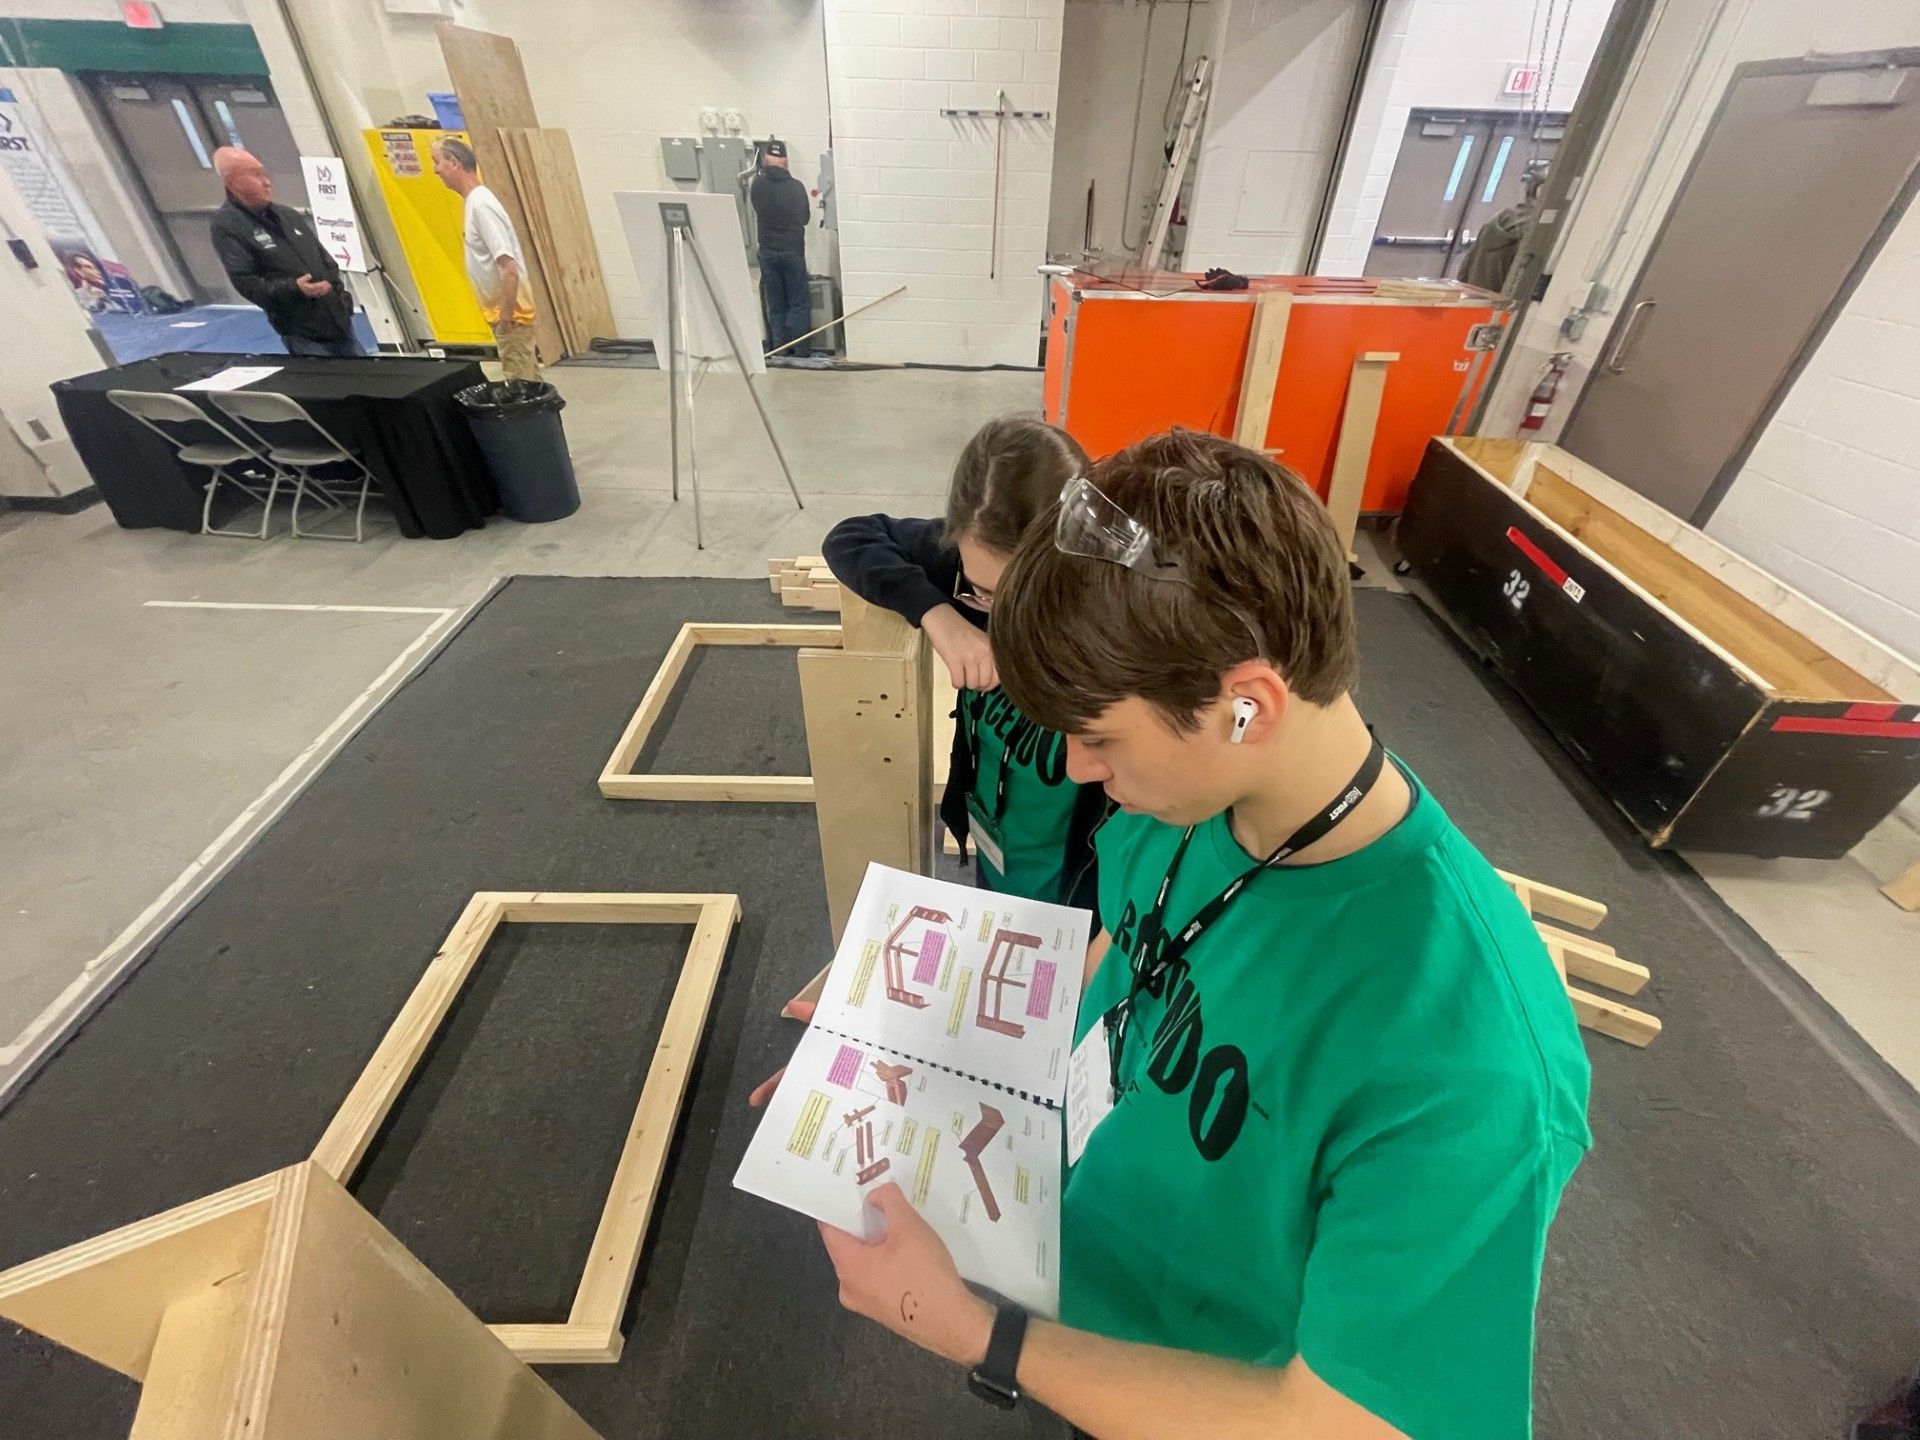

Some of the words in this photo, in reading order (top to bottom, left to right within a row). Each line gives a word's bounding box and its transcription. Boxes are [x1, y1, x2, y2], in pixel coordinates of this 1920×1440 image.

[318, 184, 337, 195] FIRST
[317, 216, 354, 228] Competition
[331, 231, 347, 242] Field
[1502, 569, 1530, 610] 32
[1757, 787, 1832, 820] 32
